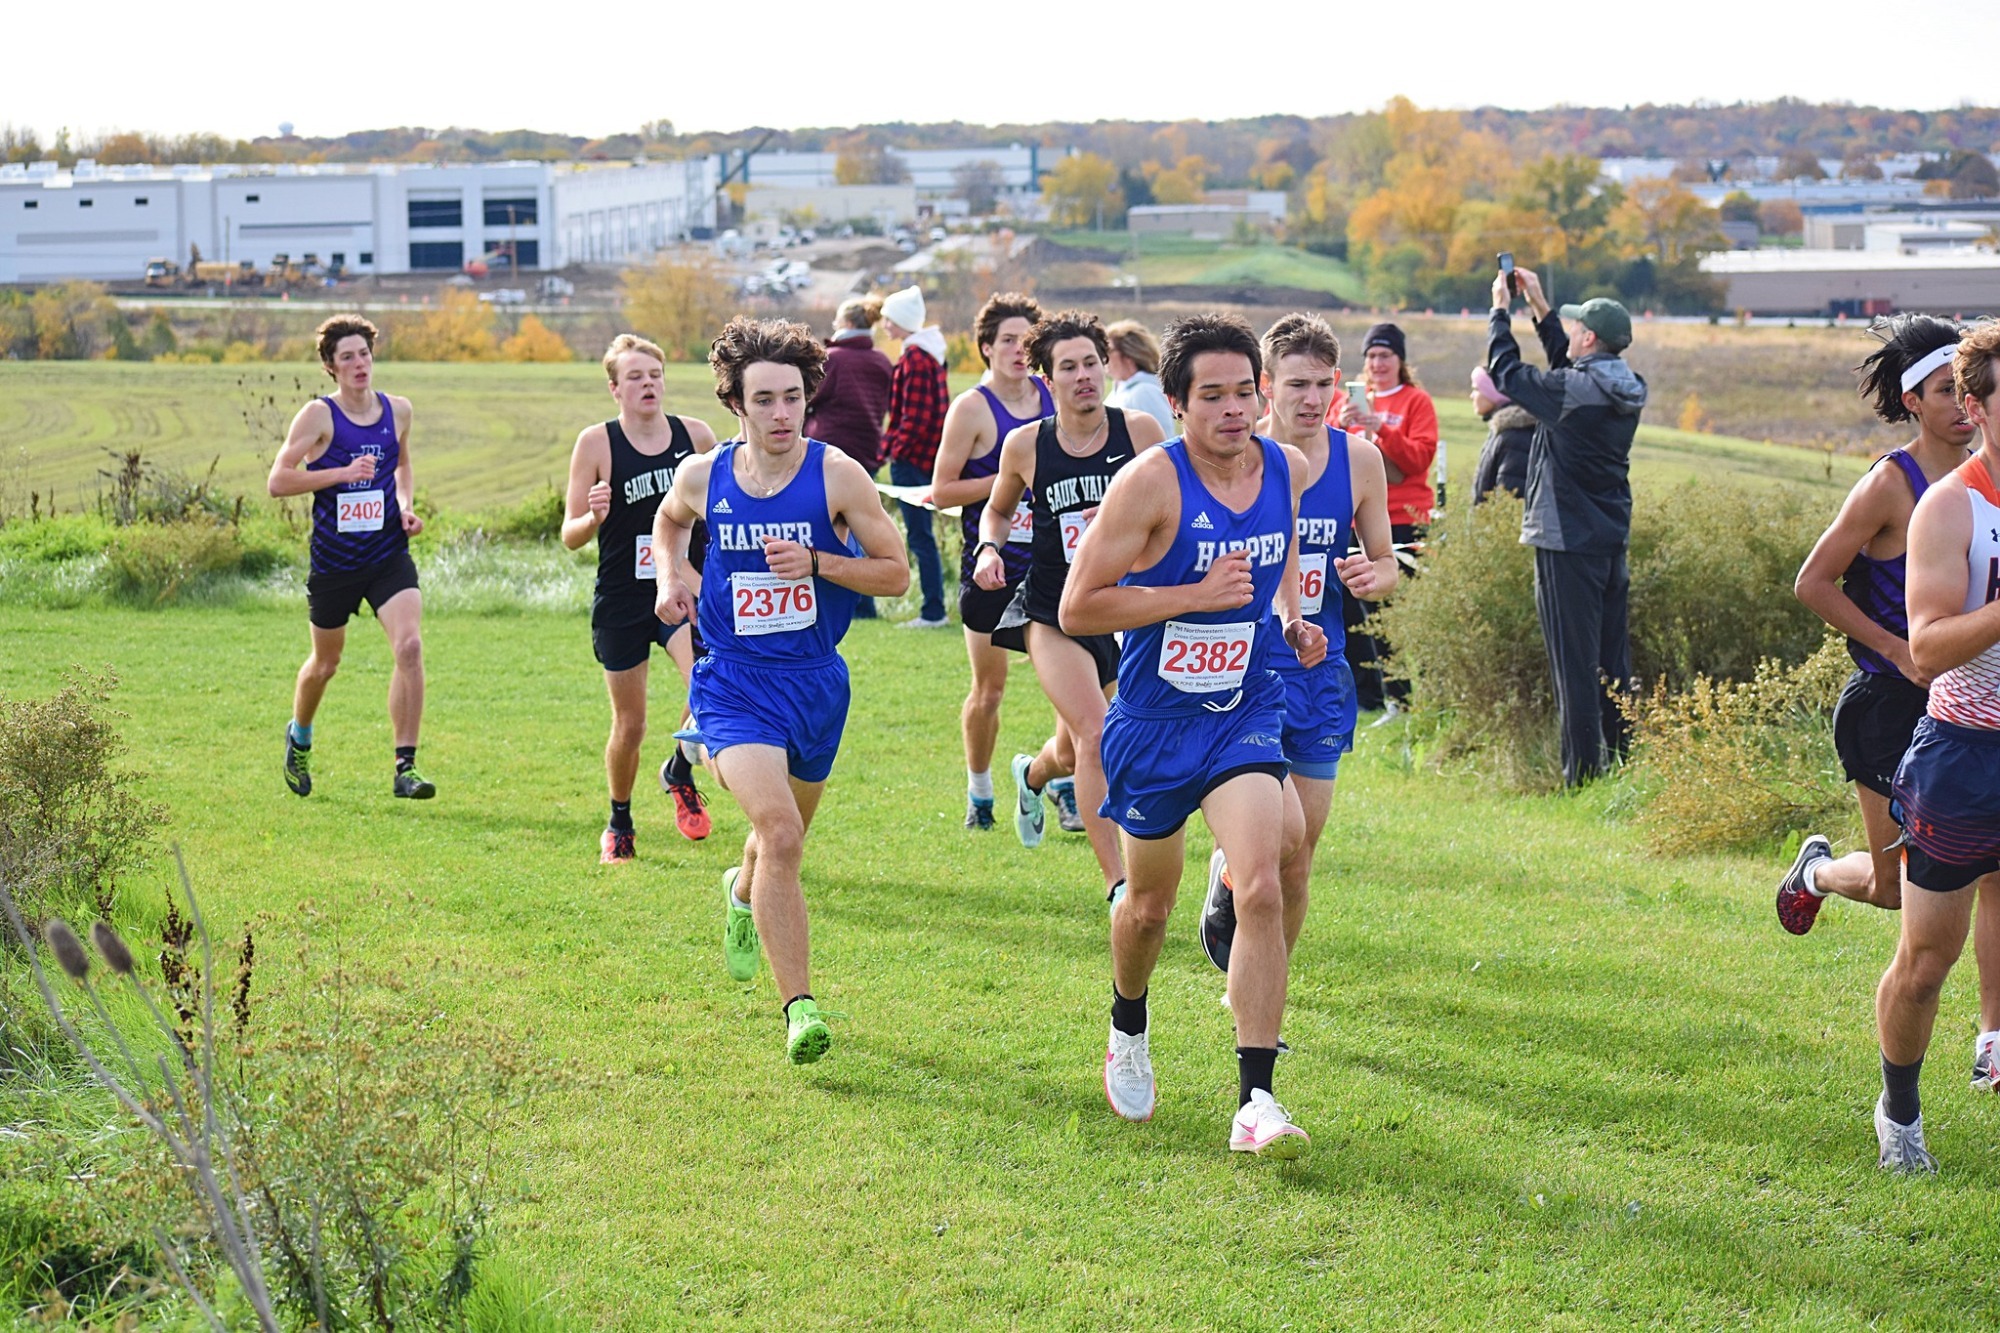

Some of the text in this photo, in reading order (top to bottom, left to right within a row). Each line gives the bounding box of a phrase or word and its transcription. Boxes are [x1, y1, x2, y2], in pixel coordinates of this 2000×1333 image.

[624, 471, 655, 505] SAUK
[1046, 477, 1080, 513] SAUK
[340, 501, 383, 521] 2402
[1191, 521, 1214, 530] adidas
[718, 522, 813, 550] HARPER
[736, 583, 813, 617] 2376
[1183, 626, 1224, 634] Northwestern
[1163, 640, 1249, 674] 2382
